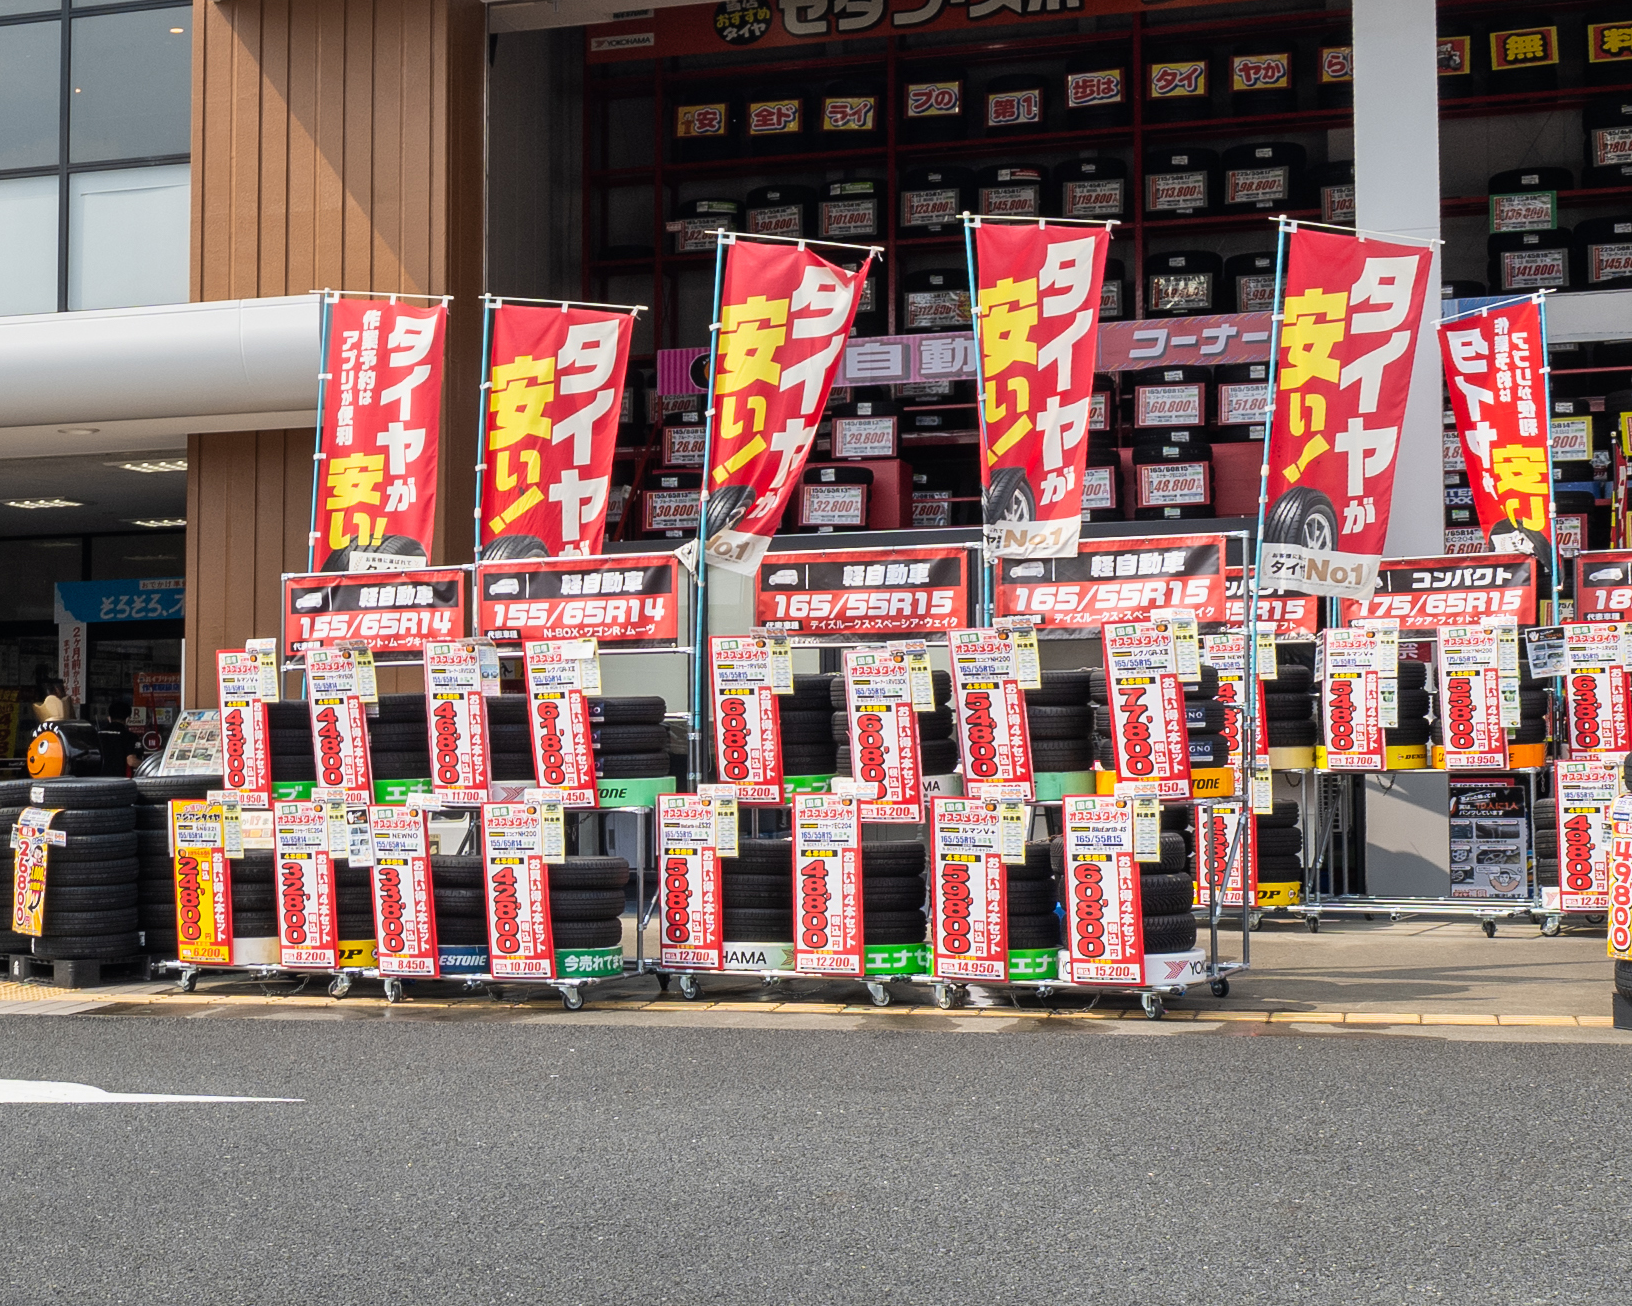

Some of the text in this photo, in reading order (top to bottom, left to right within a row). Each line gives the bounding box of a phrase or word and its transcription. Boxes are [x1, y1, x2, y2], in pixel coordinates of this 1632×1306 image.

[717, 8, 770, 28] おすすめ
[723, 23, 766, 41] タイヤ
[607, 37, 650, 46] YOKOHAMA
[1153, 63, 1205, 94] タイ
[1129, 324, 1268, 358] コーナー
[358, 310, 381, 406] 作業予約は
[981, 277, 1038, 465] 安い!
[1036, 236, 1096, 506] タイヤが
[337, 333, 359, 446] アプリが便利
[712, 296, 788, 483] 安い!
[754, 265, 858, 522] タイヤが
[1280, 288, 1348, 483] 安い!
[1334, 255, 1419, 536] タイヤが
[379, 313, 437, 513] タイヤが
[1150, 400, 1191, 413] 60,800
[488, 355, 556, 535] 安い!
[846, 432, 884, 445] 29,800
[1154, 478, 1196, 492] 48,800
[326, 452, 387, 549] 安い!
[656, 505, 693, 517] 30,800
[814, 500, 853, 512] 32,800
[1004, 527, 1064, 551] No.1
[843, 561, 930, 586] 軽自動車
[1091, 551, 1185, 577] 軽自動車
[1306, 558, 1366, 585] No.1
[1411, 566, 1502, 589] コンパクト
[358, 585, 434, 608] 軽自動車
[561, 571, 644, 596] 軽自動車
[1014, 577, 1210, 612] 165/55R15
[494, 596, 667, 628] 155/65R14
[774, 590, 954, 619] 165/55R15
[1355, 590, 1520, 619] 175/65R15
[299, 611, 452, 639] 155/65R14
[543, 624, 656, 639] N-BOX・ワゴンR・ムーヴ
[936, 810, 999, 824] オススメタイヤ
[530, 858, 549, 953] お買い得4本セット
